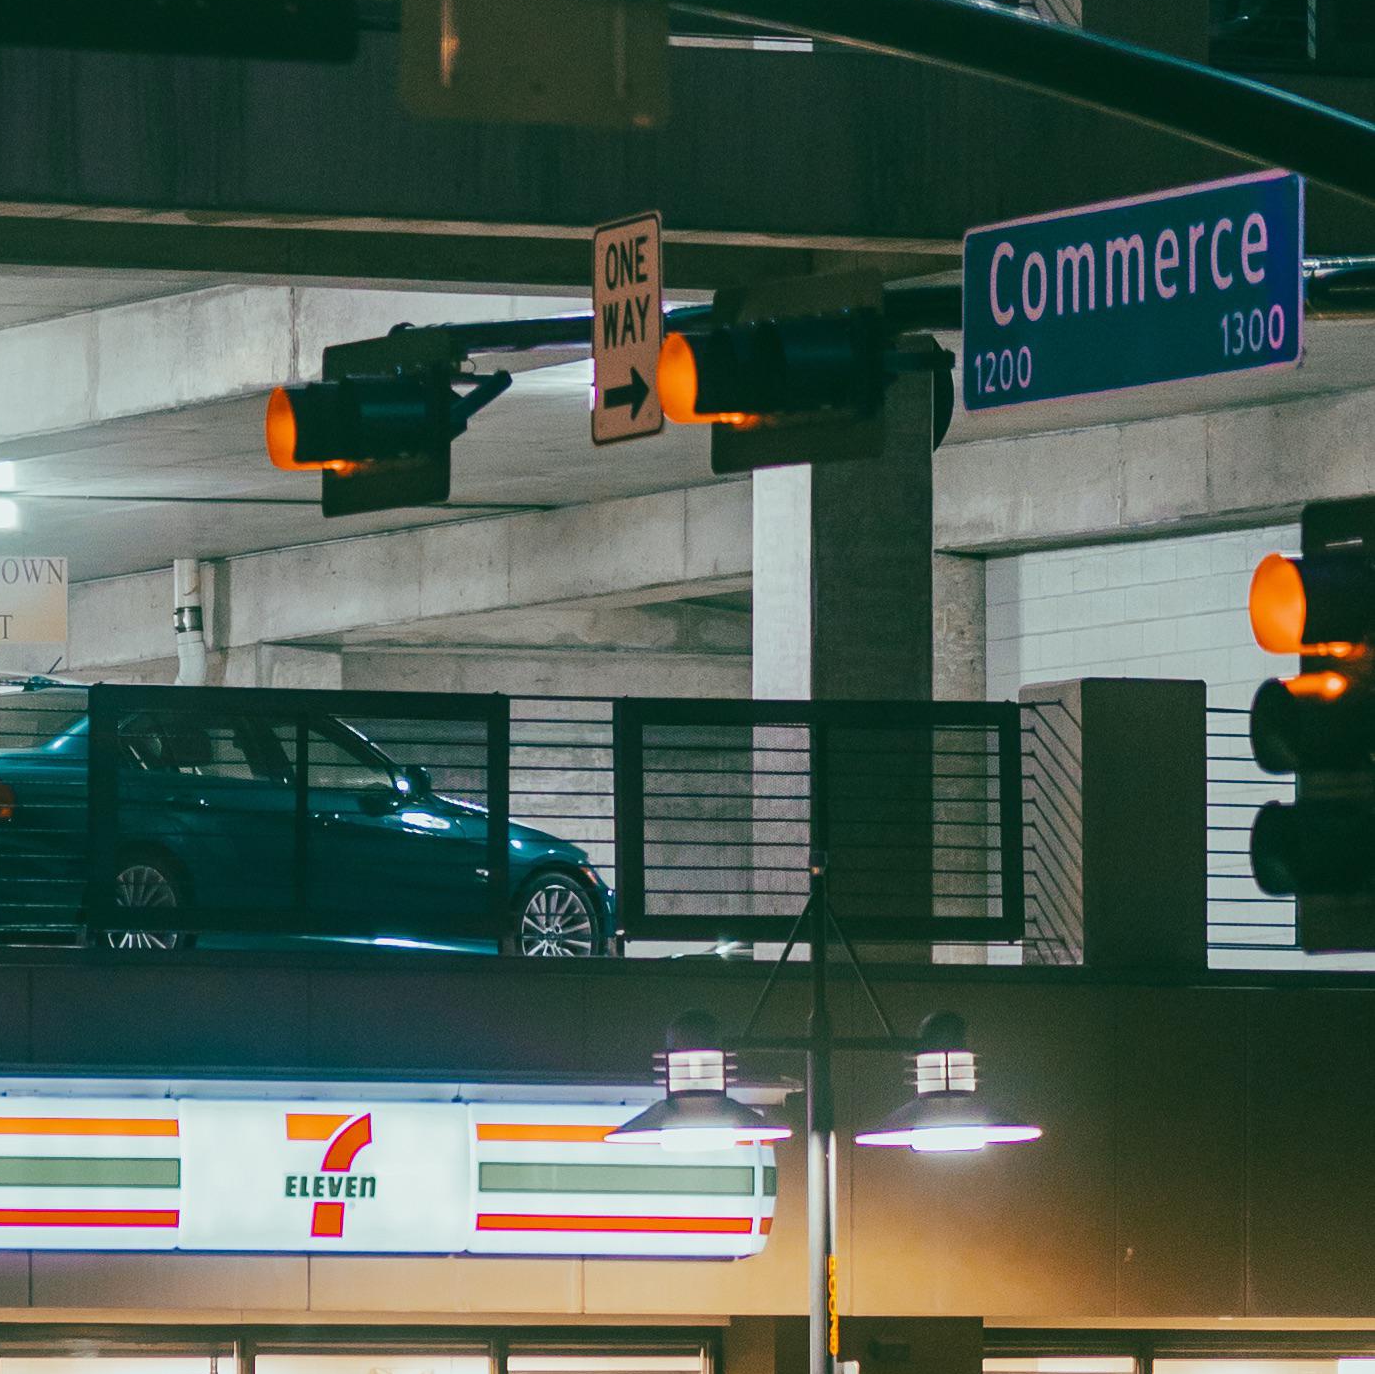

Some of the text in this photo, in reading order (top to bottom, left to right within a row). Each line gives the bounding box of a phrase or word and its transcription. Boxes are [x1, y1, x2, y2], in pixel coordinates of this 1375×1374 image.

[605, 235, 648, 291] ONE
[989, 212, 1268, 327] Commerce
[602, 294, 651, 350] WAY
[1221, 303, 1285, 356] 1300
[975, 345, 1032, 395] 1200
[285, 1112, 372, 1237] 7
